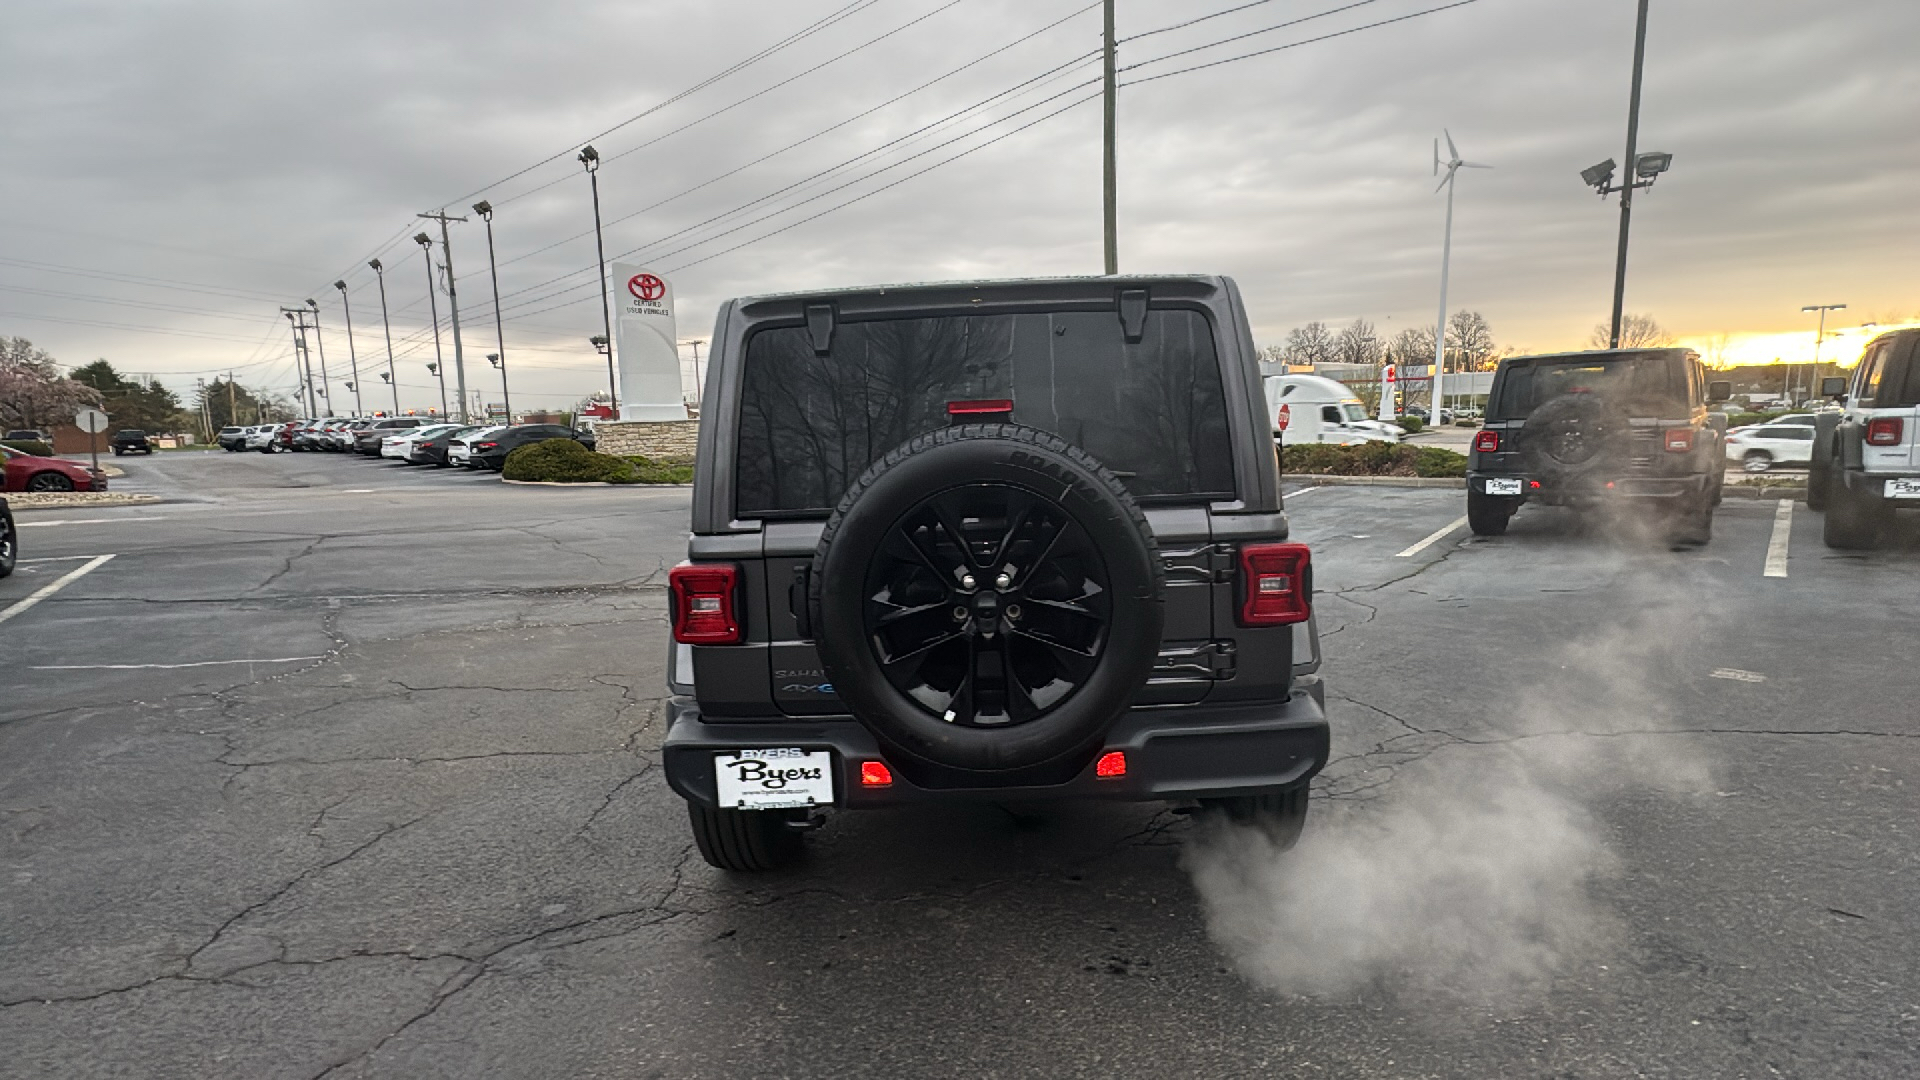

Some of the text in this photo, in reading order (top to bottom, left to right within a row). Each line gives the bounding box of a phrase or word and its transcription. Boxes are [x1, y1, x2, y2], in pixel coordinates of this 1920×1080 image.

[644, 308, 668, 316] VEHICLES
[1279, 411, 1290, 422] STOP
[775, 670, 825, 678] SAHA
[740, 748, 802, 759] BYERS
[726, 759, 822, 789] Byers
